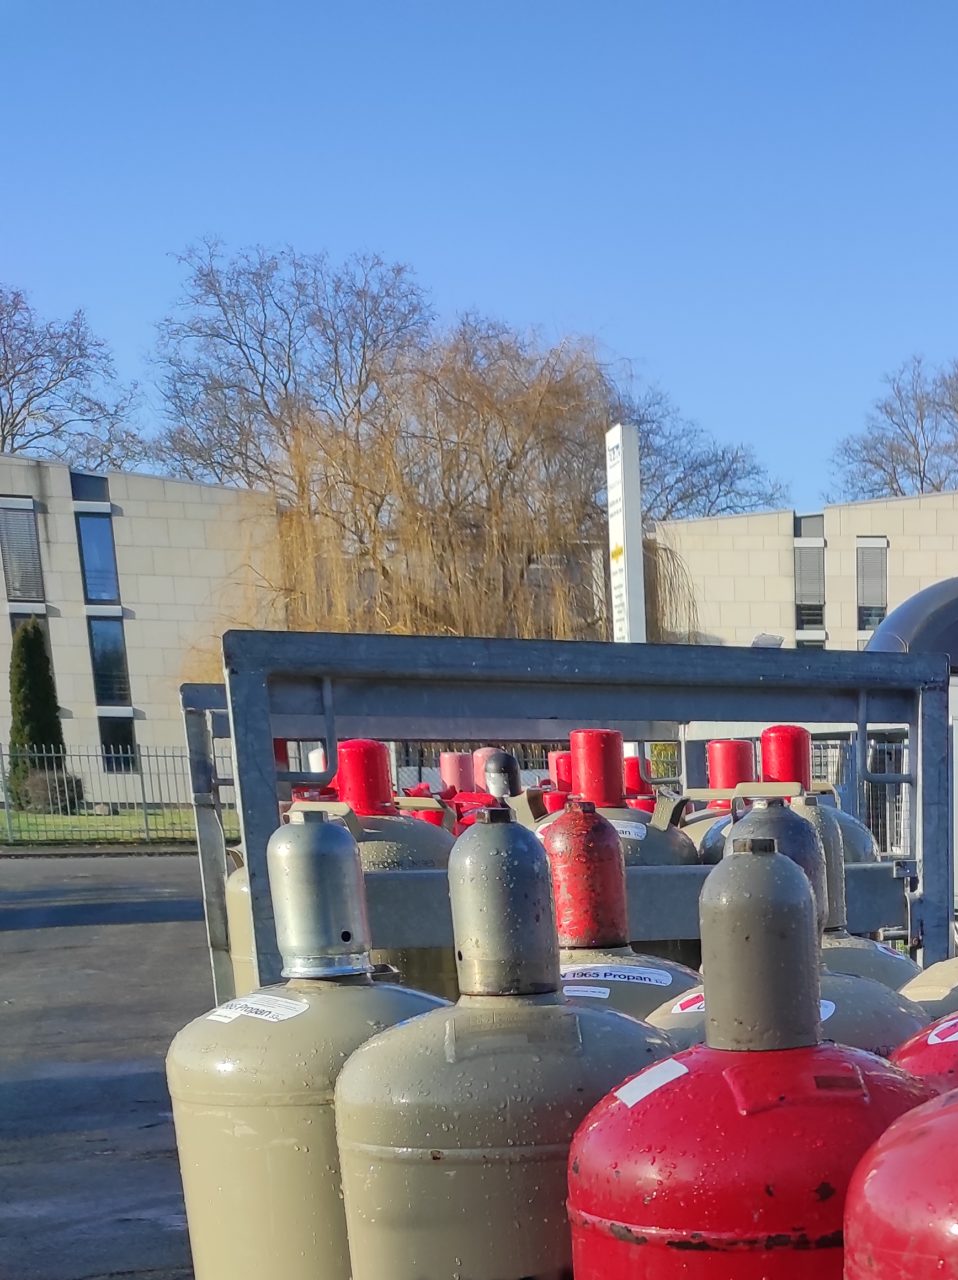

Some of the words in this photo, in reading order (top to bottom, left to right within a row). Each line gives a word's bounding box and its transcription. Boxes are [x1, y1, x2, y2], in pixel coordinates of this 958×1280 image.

[572, 971, 600, 979] 1965
[603, 972, 652, 983] Propan
[239, 1003, 272, 1016] Propan
